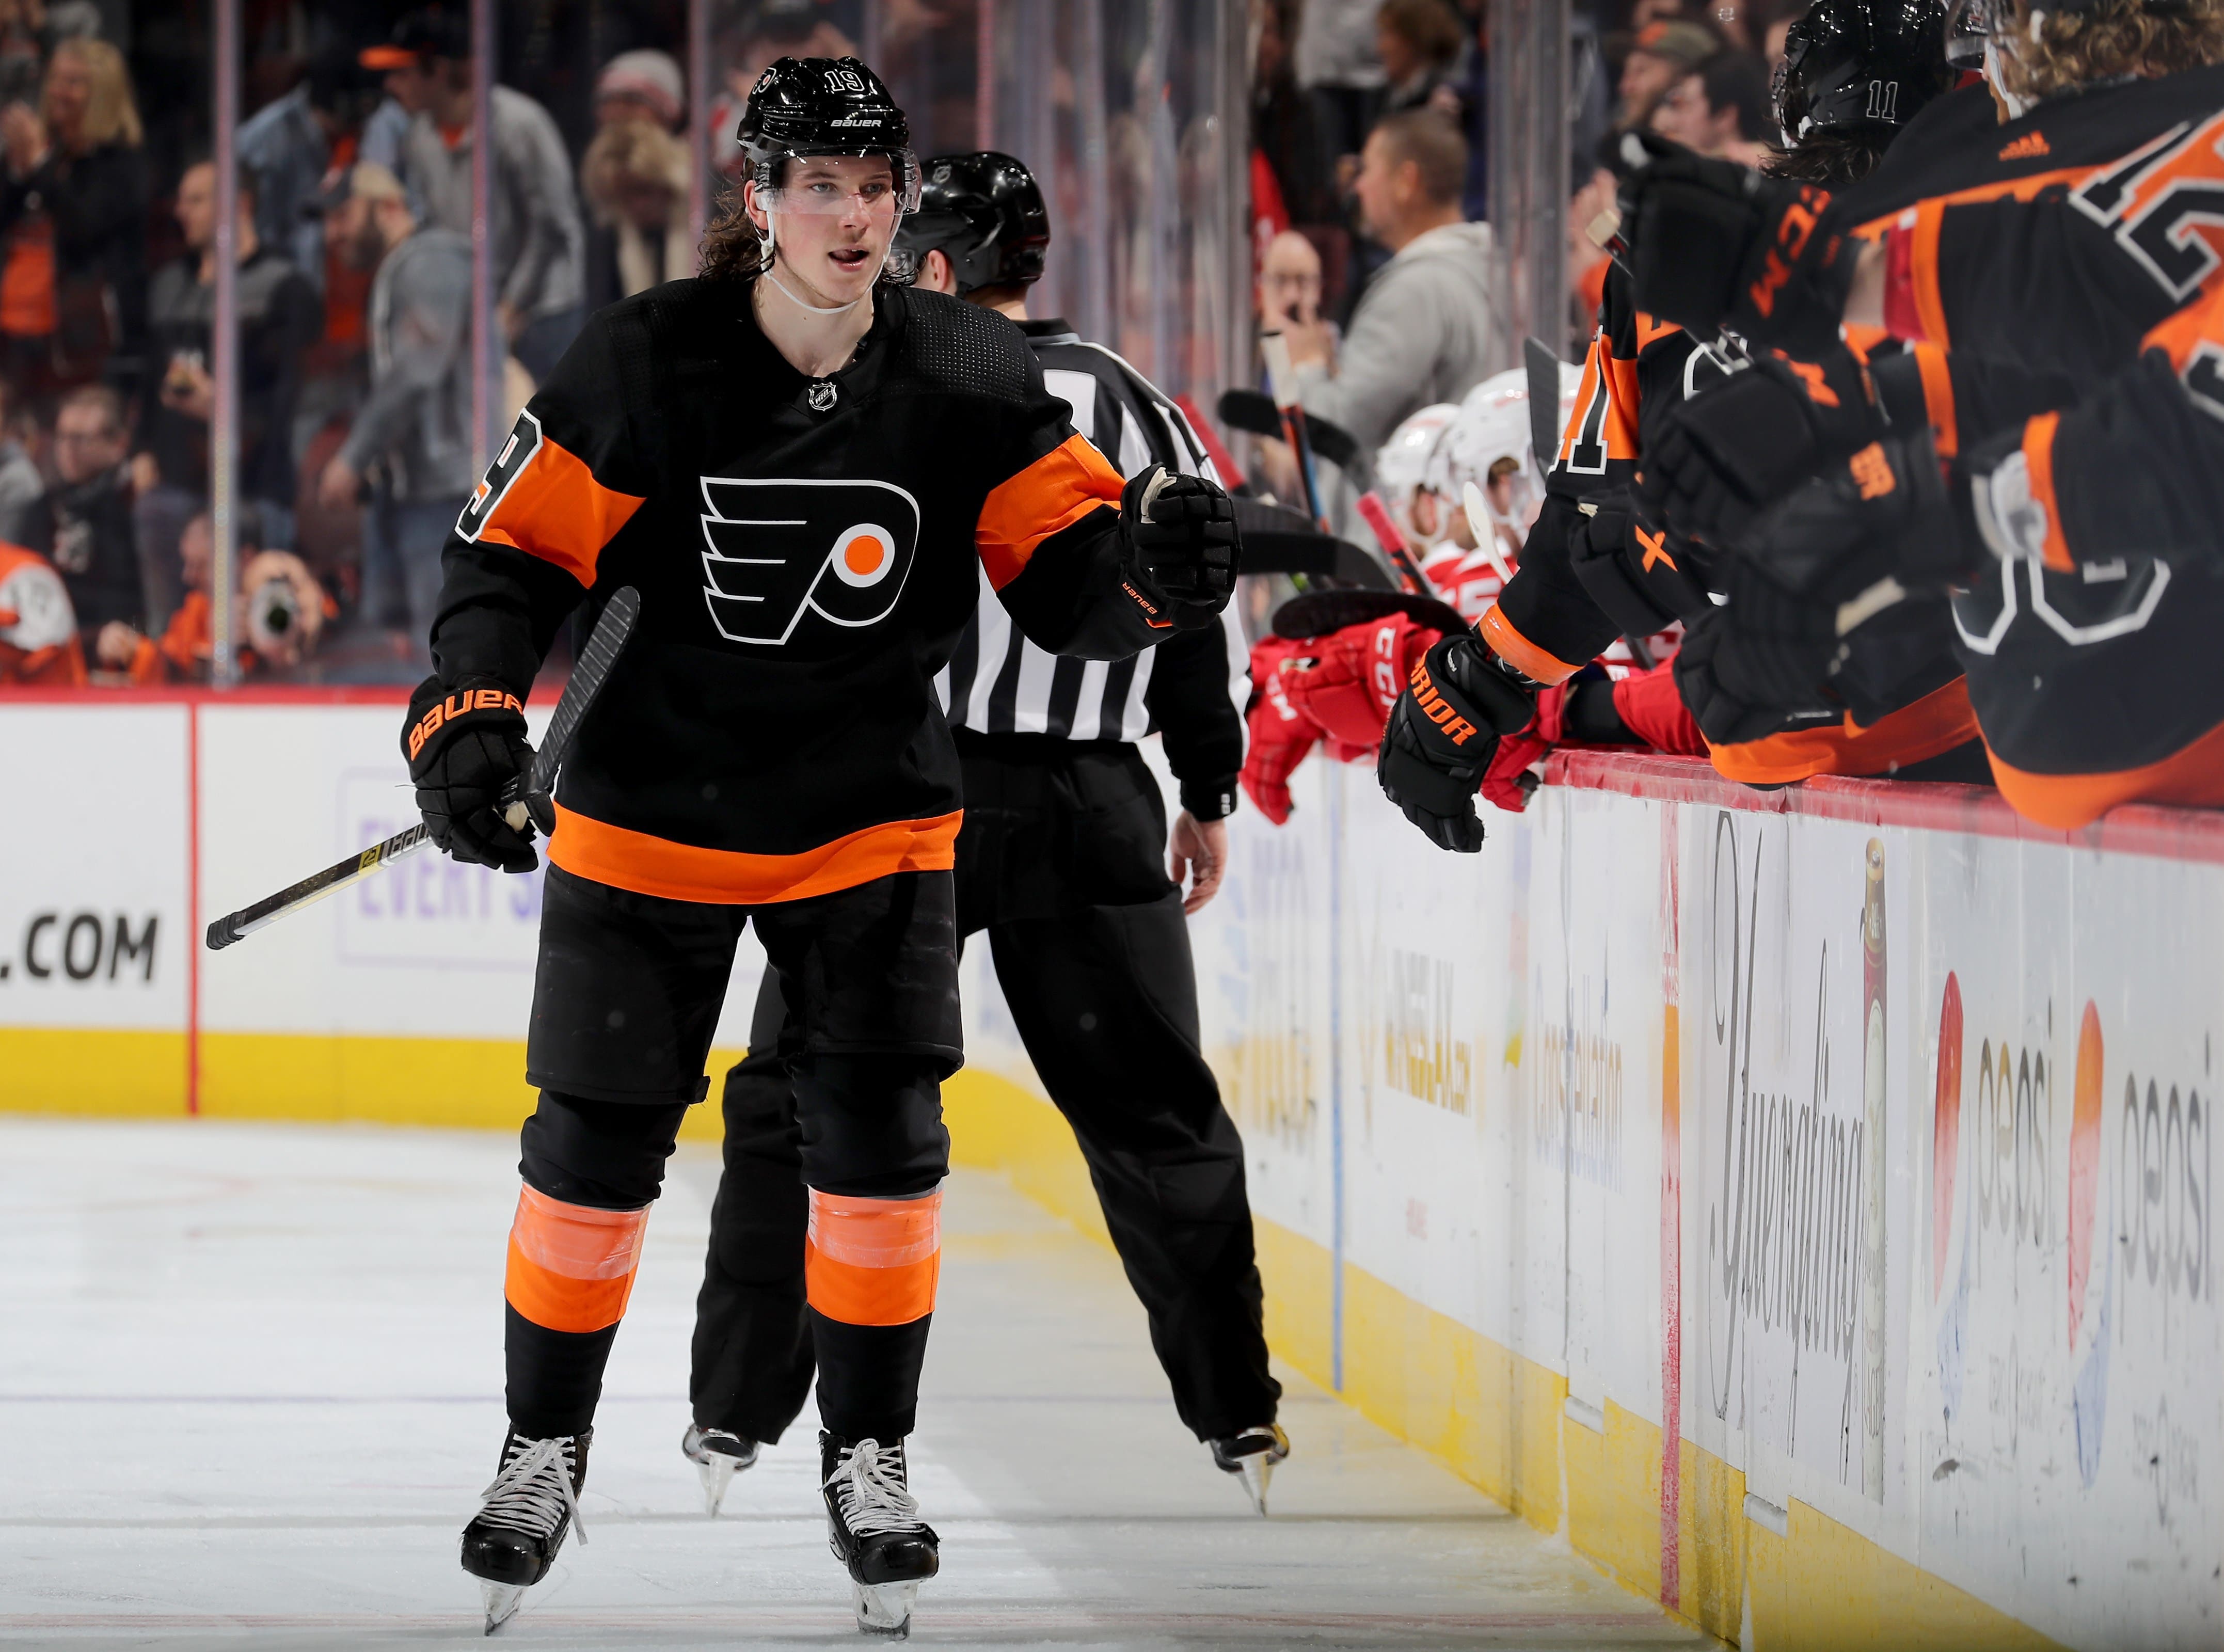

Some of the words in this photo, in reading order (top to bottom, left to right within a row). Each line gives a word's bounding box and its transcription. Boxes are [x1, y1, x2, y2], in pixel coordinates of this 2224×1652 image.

[824, 71, 865, 91] 19
[1867, 80, 1898, 119] 11
[1122, 582, 1157, 614] BAUER
[1375, 627, 1398, 712] CC
[1410, 642, 1478, 745] RIOR
[409, 689, 523, 761] BAUER
[1978, 996, 2052, 1305] pepsi
[2119, 1030, 2211, 1363] pepsi
